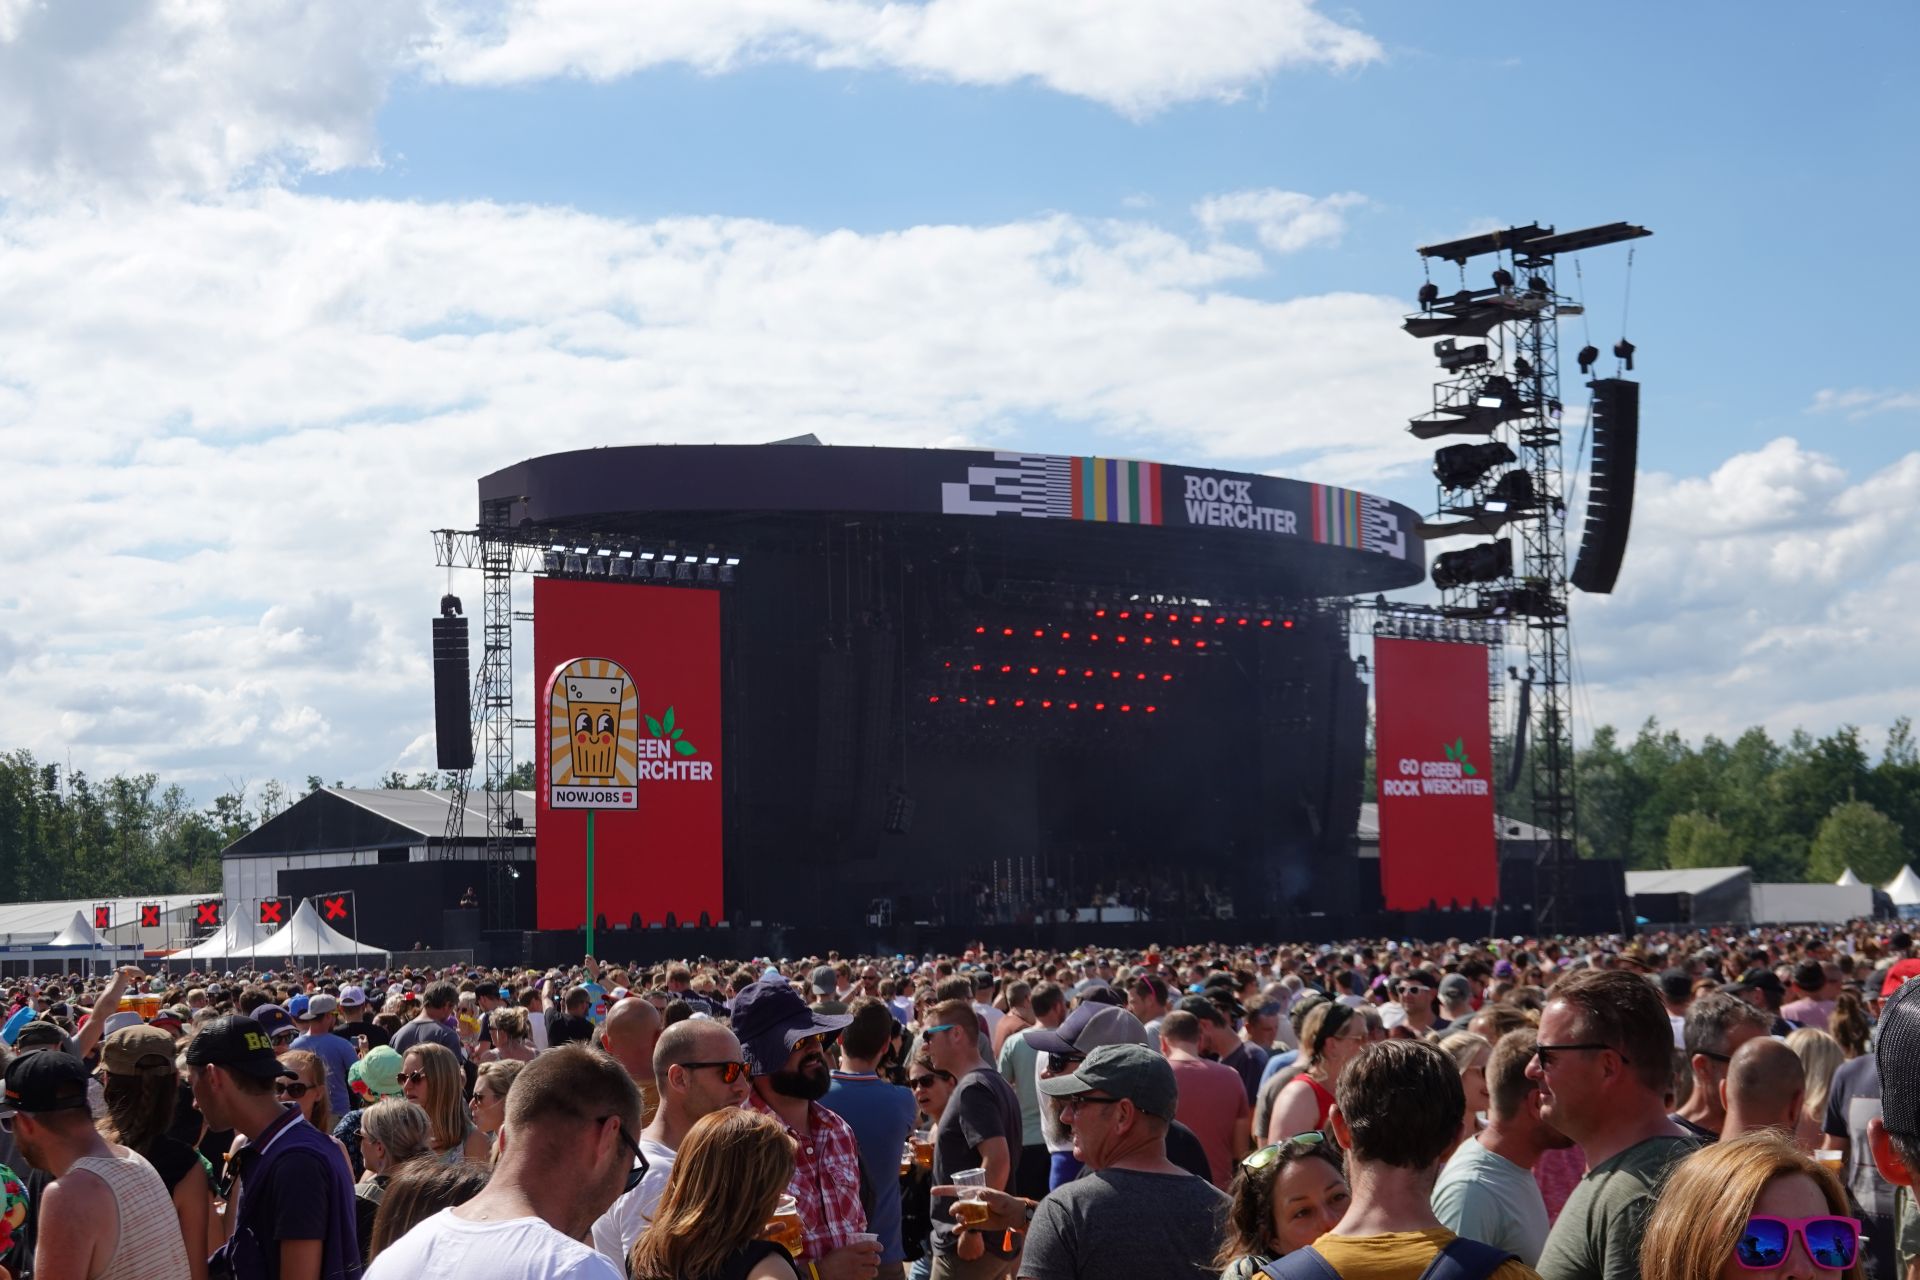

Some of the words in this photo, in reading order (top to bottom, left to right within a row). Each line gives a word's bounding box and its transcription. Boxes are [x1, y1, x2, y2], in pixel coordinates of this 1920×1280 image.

[1184, 475, 1252, 503] ROCK
[1185, 499, 1297, 533] WERCHTER
[1399, 759, 1419, 775] GO
[1421, 762, 1462, 778] GREEN
[556, 791, 620, 802] NOWJOBS
[1384, 779, 1421, 796] ROCK
[1421, 778, 1488, 795] WERCHTER
